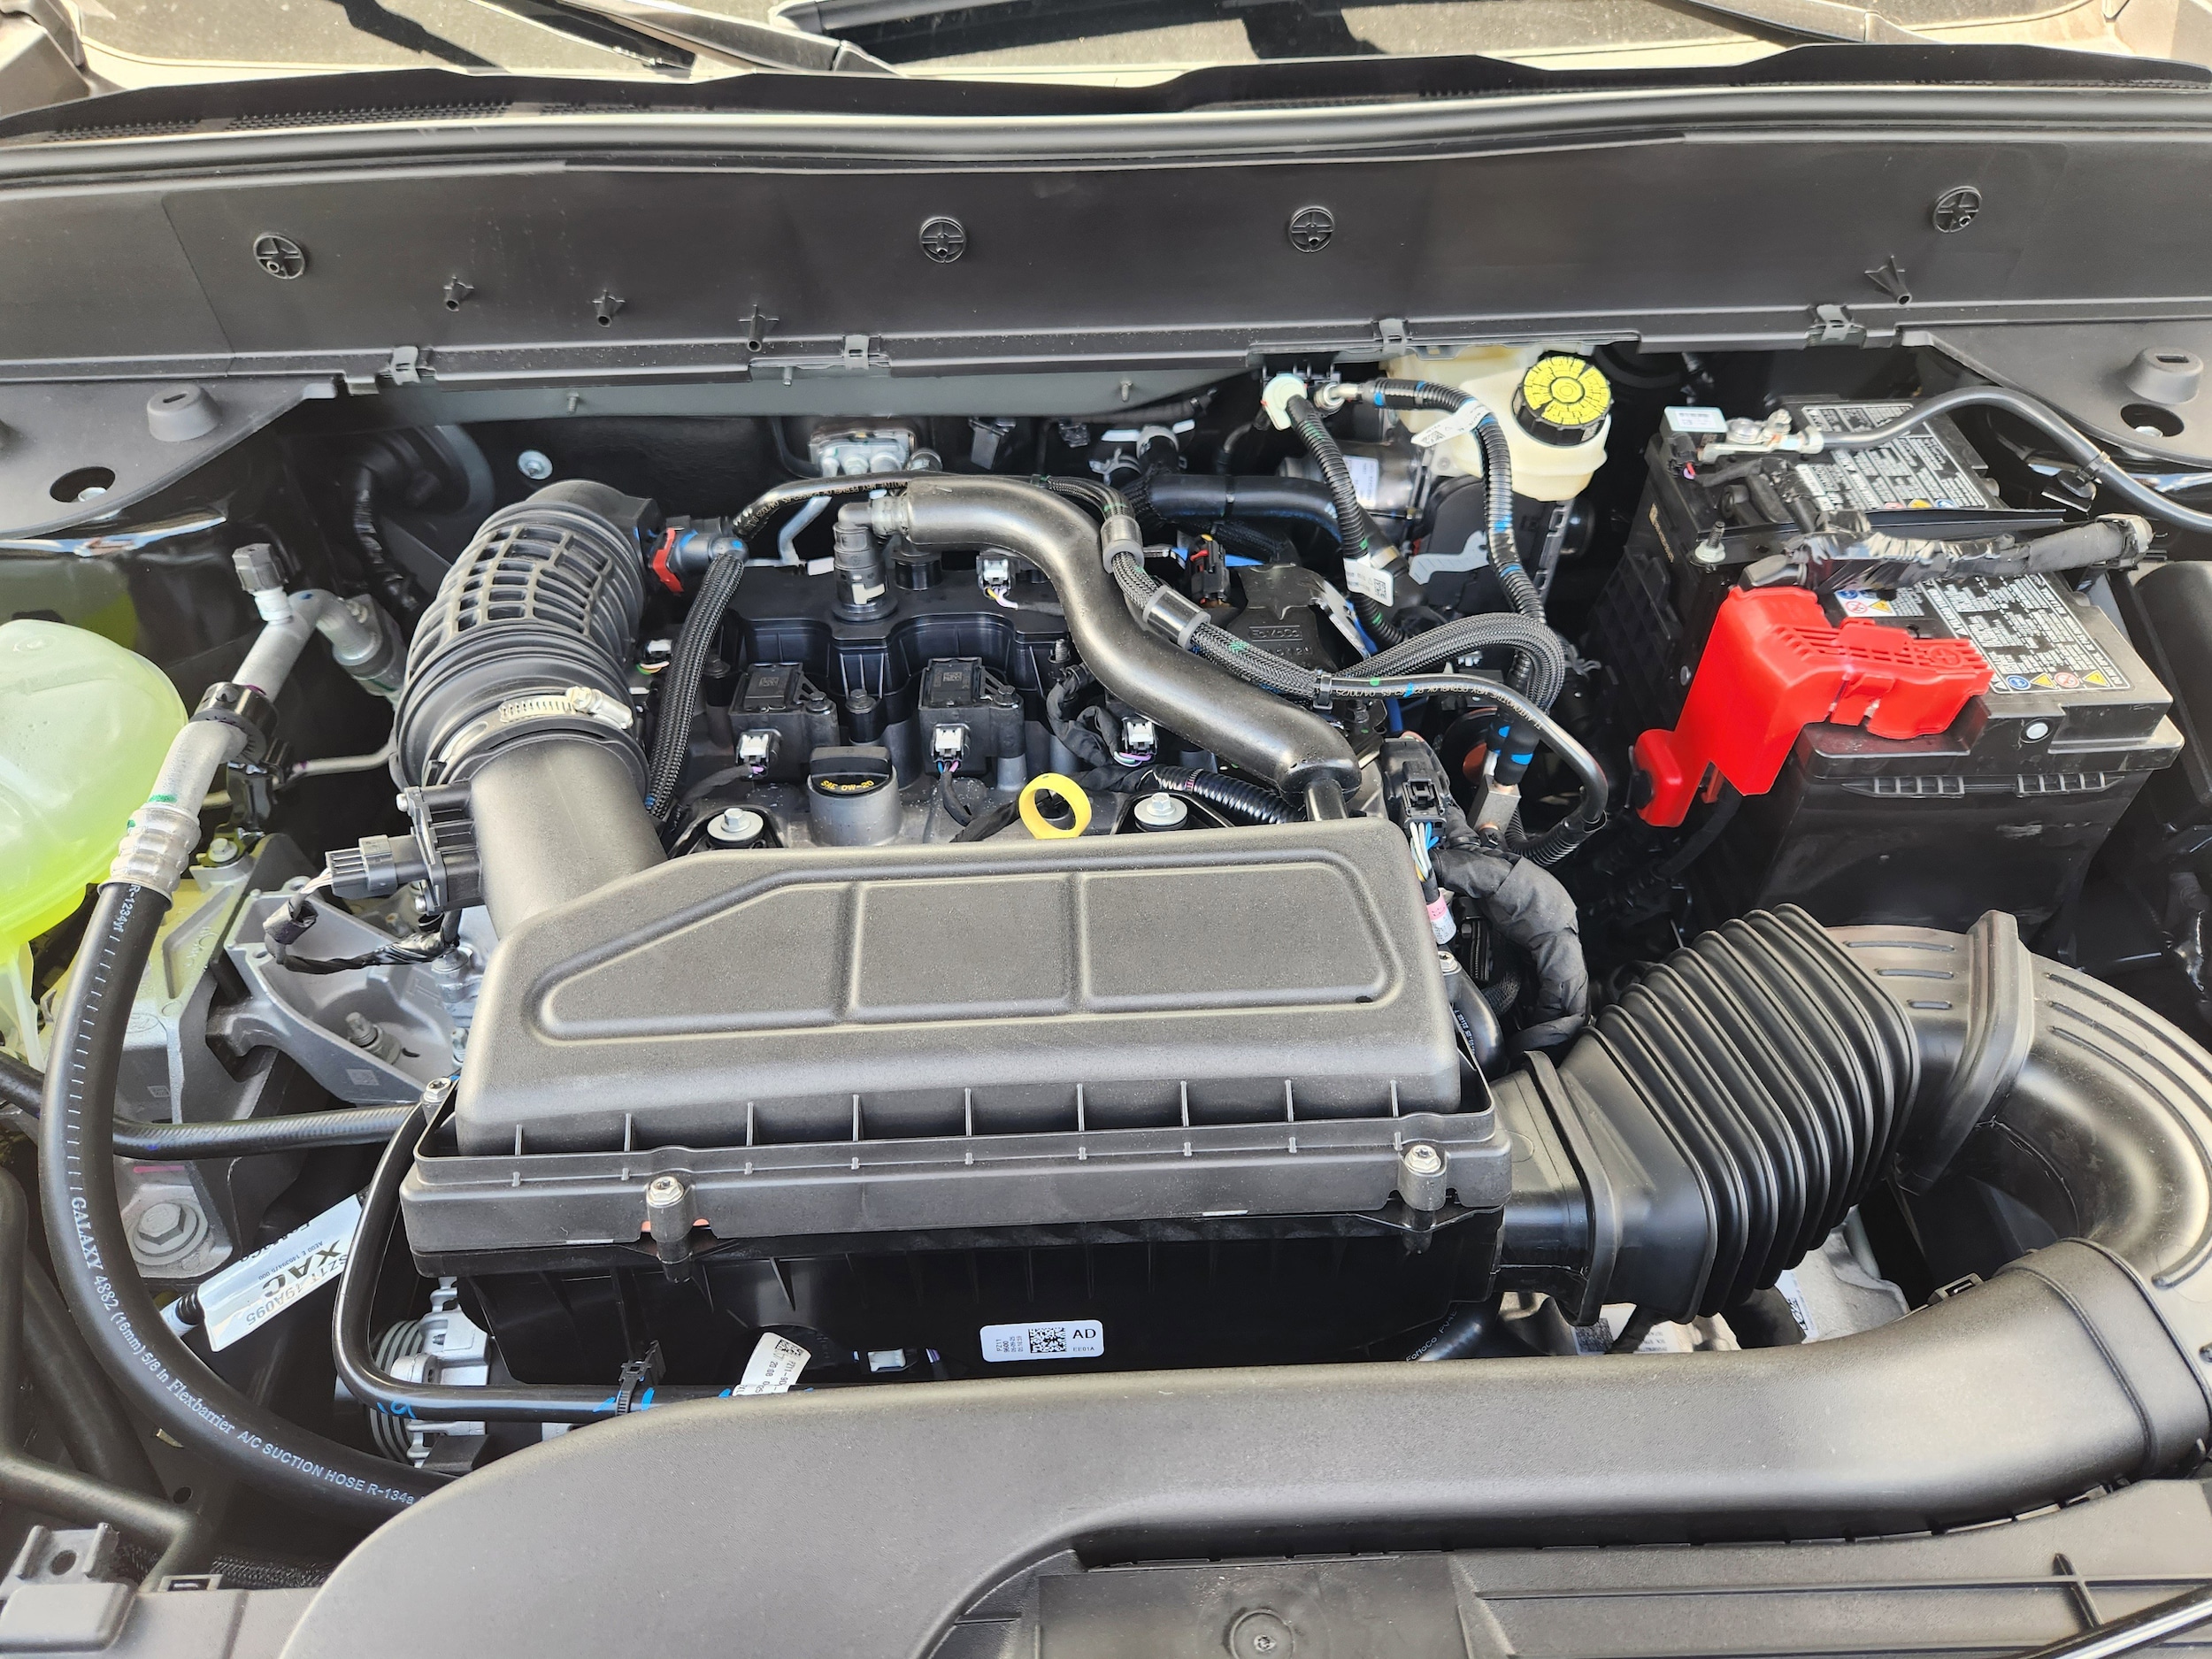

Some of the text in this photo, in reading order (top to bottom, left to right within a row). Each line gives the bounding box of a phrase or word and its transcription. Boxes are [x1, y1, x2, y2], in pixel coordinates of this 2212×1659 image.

[820, 780, 838, 790] SAE
[112, 883, 142, 933] R-1234yf
[263, 1240, 342, 1297] XAC
[246, 1284, 303, 1325] 19A095
[71, 1196, 415, 1506] GALAXY 4882 (16mm) 5/8 in Flexbarrier A/C SUCTION HOSE R-134a
[1072, 1329, 1096, 1339] AD
